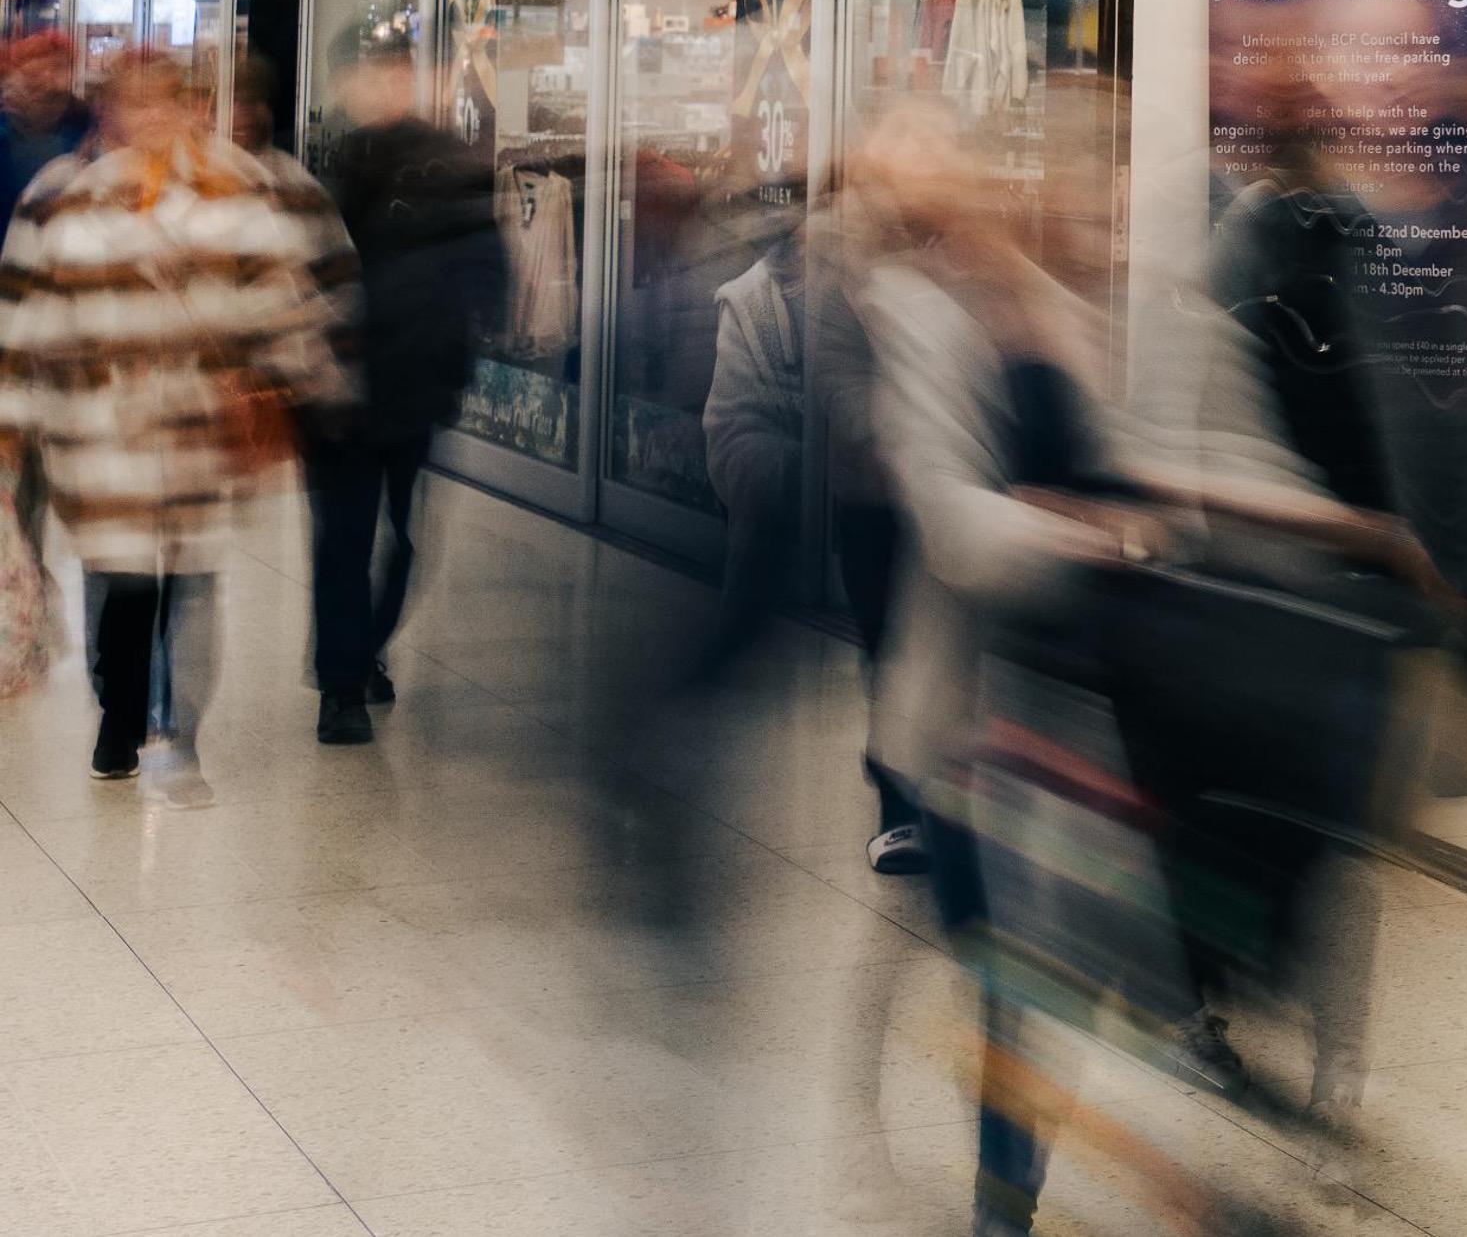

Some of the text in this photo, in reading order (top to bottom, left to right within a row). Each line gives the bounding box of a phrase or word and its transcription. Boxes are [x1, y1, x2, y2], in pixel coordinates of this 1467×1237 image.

[1242, 33, 1441, 49] Unfortunately, BCP Council have
[1351, 52, 1371, 64] the
[1375, 51, 1400, 64] free
[1403, 51, 1450, 66] parking
[1338, 71, 1363, 83] this
[1330, 106, 1343, 118] to
[1347, 106, 1374, 120] help
[1378, 106, 1404, 118] with
[1407, 106, 1428, 118] the
[1213, 125, 1264, 140] ongoing
[1313, 124, 1346, 139] living
[1350, 124, 1385, 138] crisis,
[1388, 126, 1407, 136] we
[1411, 126, 1429, 136] are
[1216, 144, 1236, 154] our
[1320, 142, 1354, 154] hours
[1358, 142, 1383, 154] free
[1386, 142, 1432, 156] parking
[1225, 162, 1248, 174] you
[1369, 161, 1380, 172] in
[1383, 161, 1416, 173] store
[1418, 162, 1435, 173] on
[1438, 161, 1461, 173] the
[1377, 225, 1408, 239] 22nd
[1375, 245, 1402, 258] 8pm
[1362, 263, 1389, 276] 18th
[1392, 263, 1453, 278] December
[1378, 283, 1424, 297] 4.30pm
